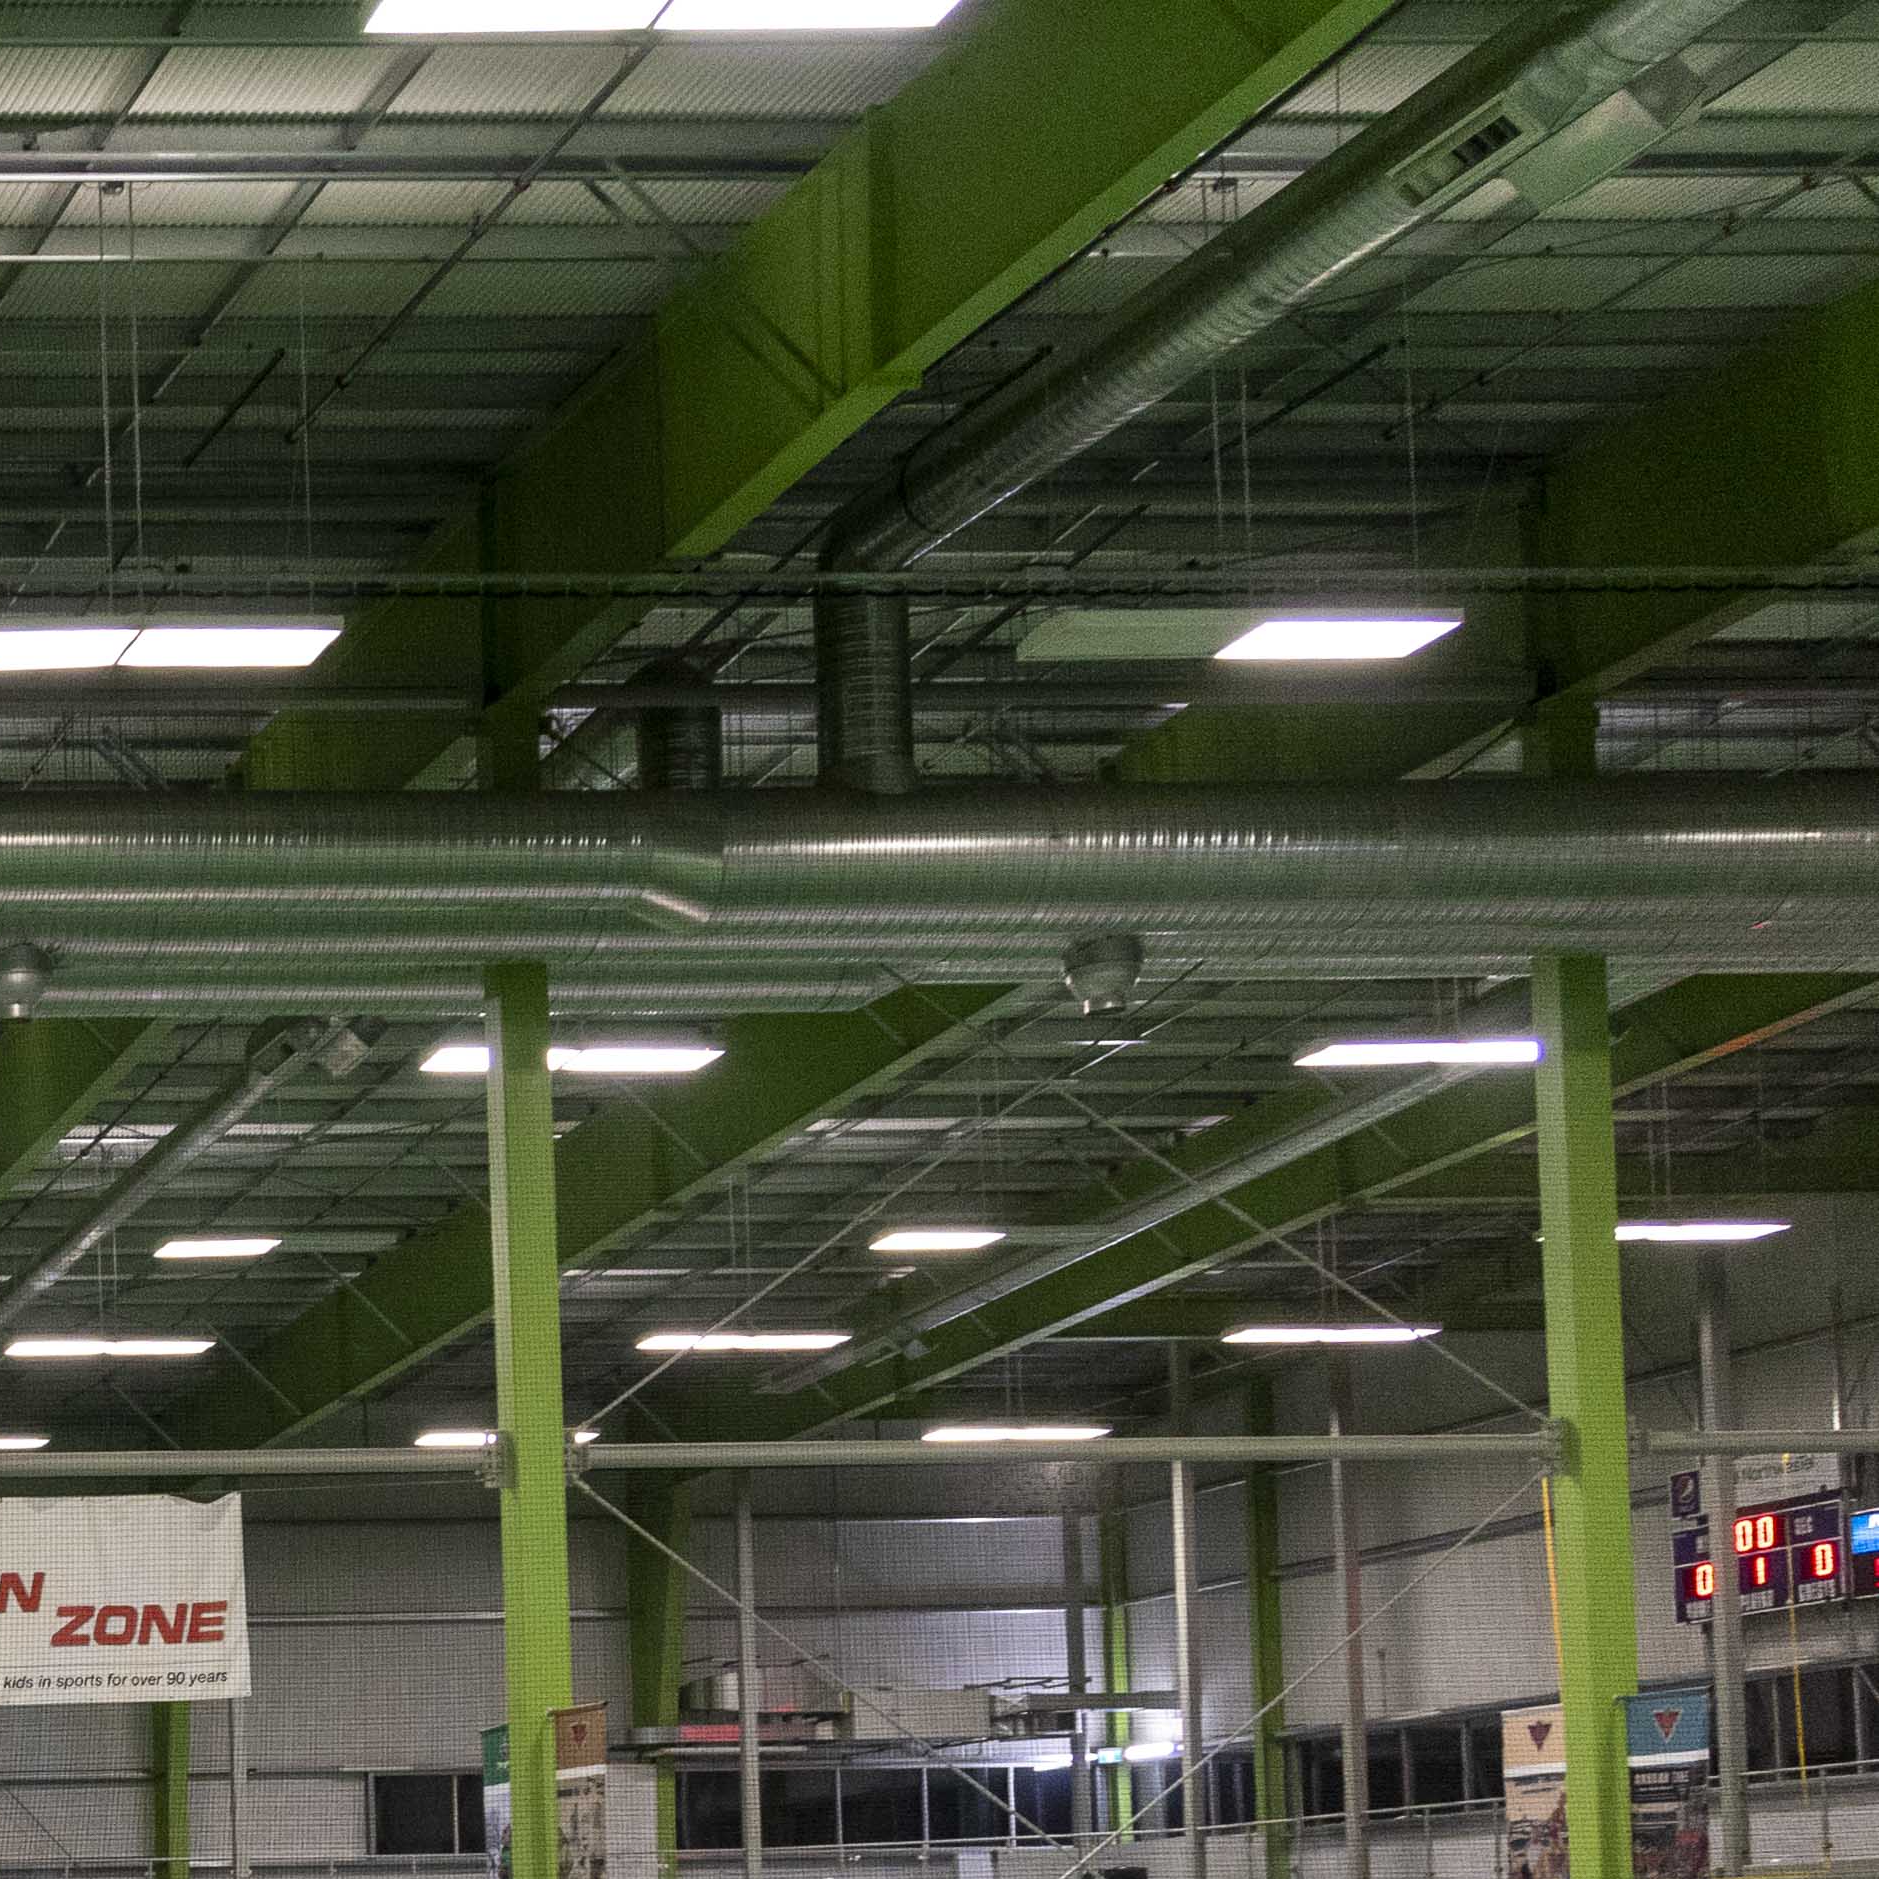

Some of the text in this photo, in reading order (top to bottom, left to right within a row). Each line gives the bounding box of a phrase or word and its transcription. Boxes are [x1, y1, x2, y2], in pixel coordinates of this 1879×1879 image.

[1814, 1543, 1834, 1577] 0
[50, 1600, 227, 1647] ZONE
[3, 1676, 34, 1689] kids
[38, 1676, 52, 1688] in
[55, 1674, 103, 1690] sports
[107, 1673, 129, 1687] for
[131, 1674, 163, 1687] over
[166, 1672, 186, 1686] 90
[188, 1671, 228, 1687] years
